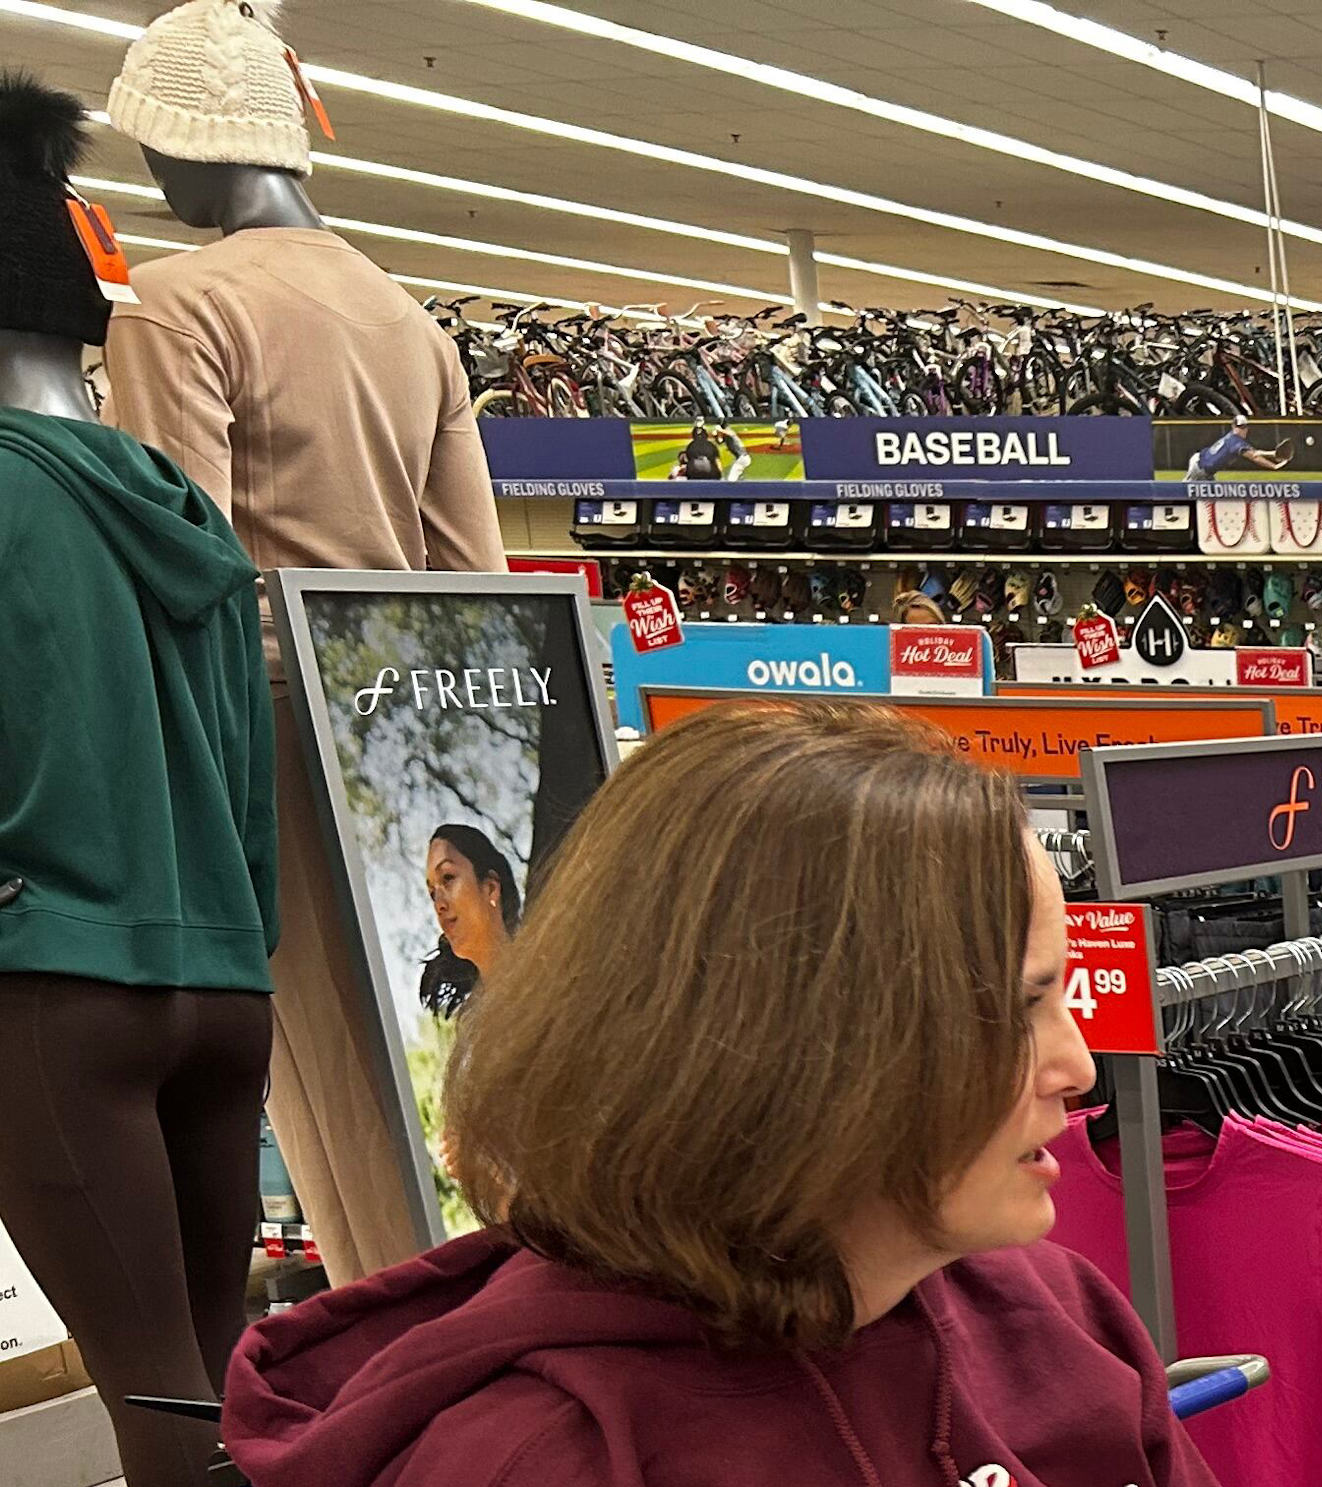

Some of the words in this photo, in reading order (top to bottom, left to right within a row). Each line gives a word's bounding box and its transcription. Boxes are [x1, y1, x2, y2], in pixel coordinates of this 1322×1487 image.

[876, 432, 1071, 467] BASEBALL
[502, 482, 553, 497] FIELDING
[554, 483, 605, 498] GLOVES
[836, 483, 894, 498] FIELDING
[895, 483, 943, 498] GLOVES
[1187, 483, 1245, 498] FIELDING
[1246, 483, 1301, 498] GLOVES
[630, 608, 676, 638] Wish
[918, 636, 955, 646] HOLIDAY
[1077, 633, 1115, 657] Wish
[900, 645, 931, 665] Hot
[933, 644, 973, 665] Deal
[747, 652, 855, 687] owala
[1244, 665, 1268, 680] Hot
[1269, 664, 1301, 680] Deal
[974, 730, 1037, 759] Truly,
[1042, 732, 1089, 755] Live
[1085, 908, 1135, 930] Value
